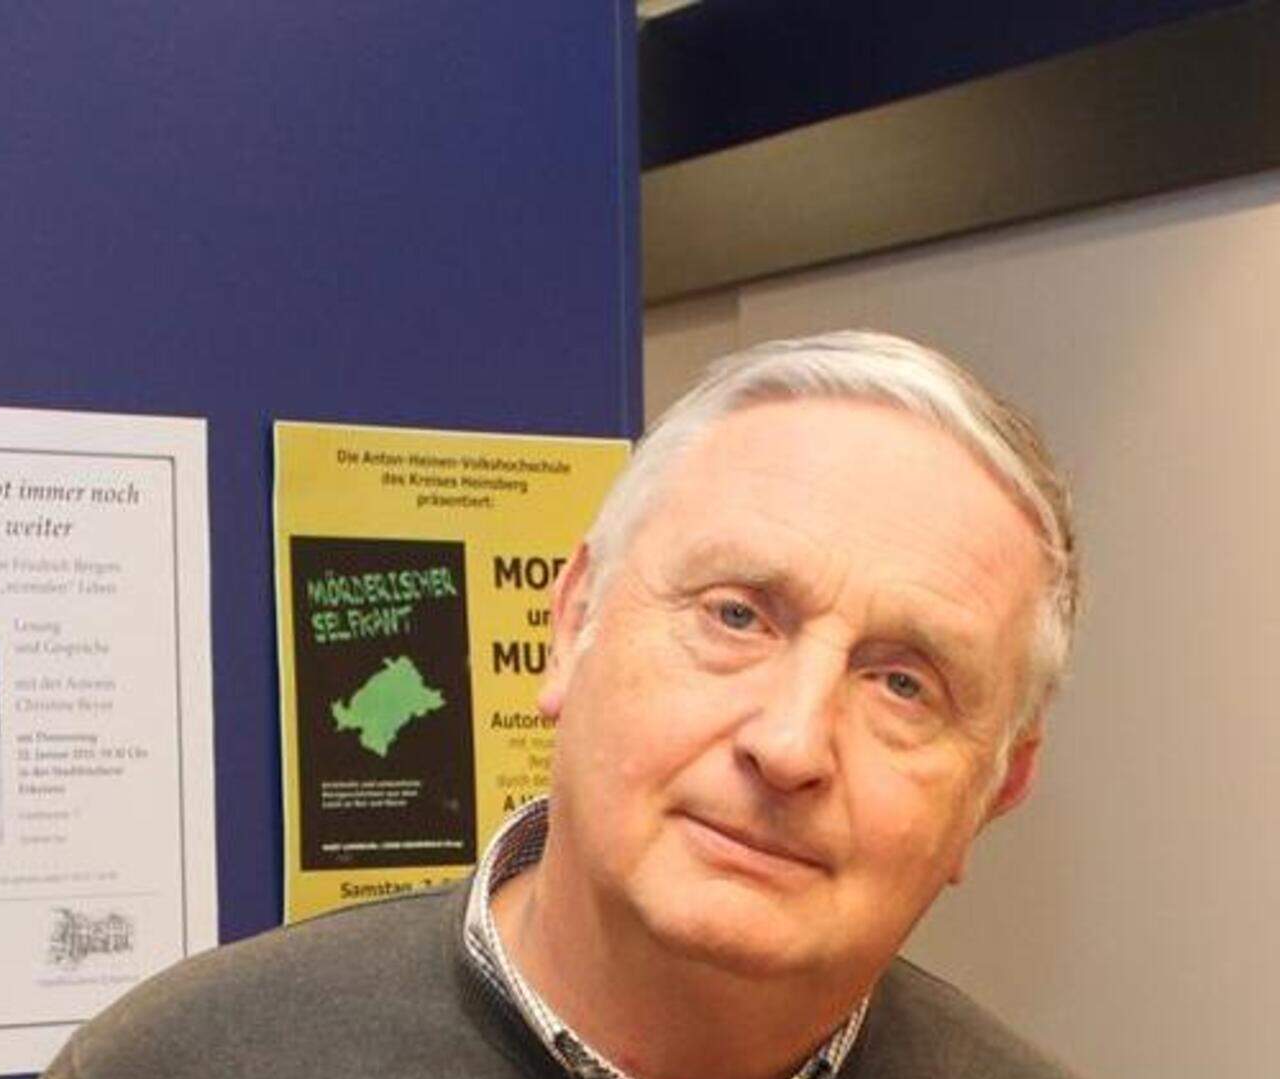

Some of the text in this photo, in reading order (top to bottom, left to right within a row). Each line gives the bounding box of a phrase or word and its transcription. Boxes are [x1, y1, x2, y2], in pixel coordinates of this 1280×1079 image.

[19, 480, 86, 502] immer
[90, 482, 140, 504] noch
[6, 516, 74, 537] weiter
[491, 641, 552, 675] MU
